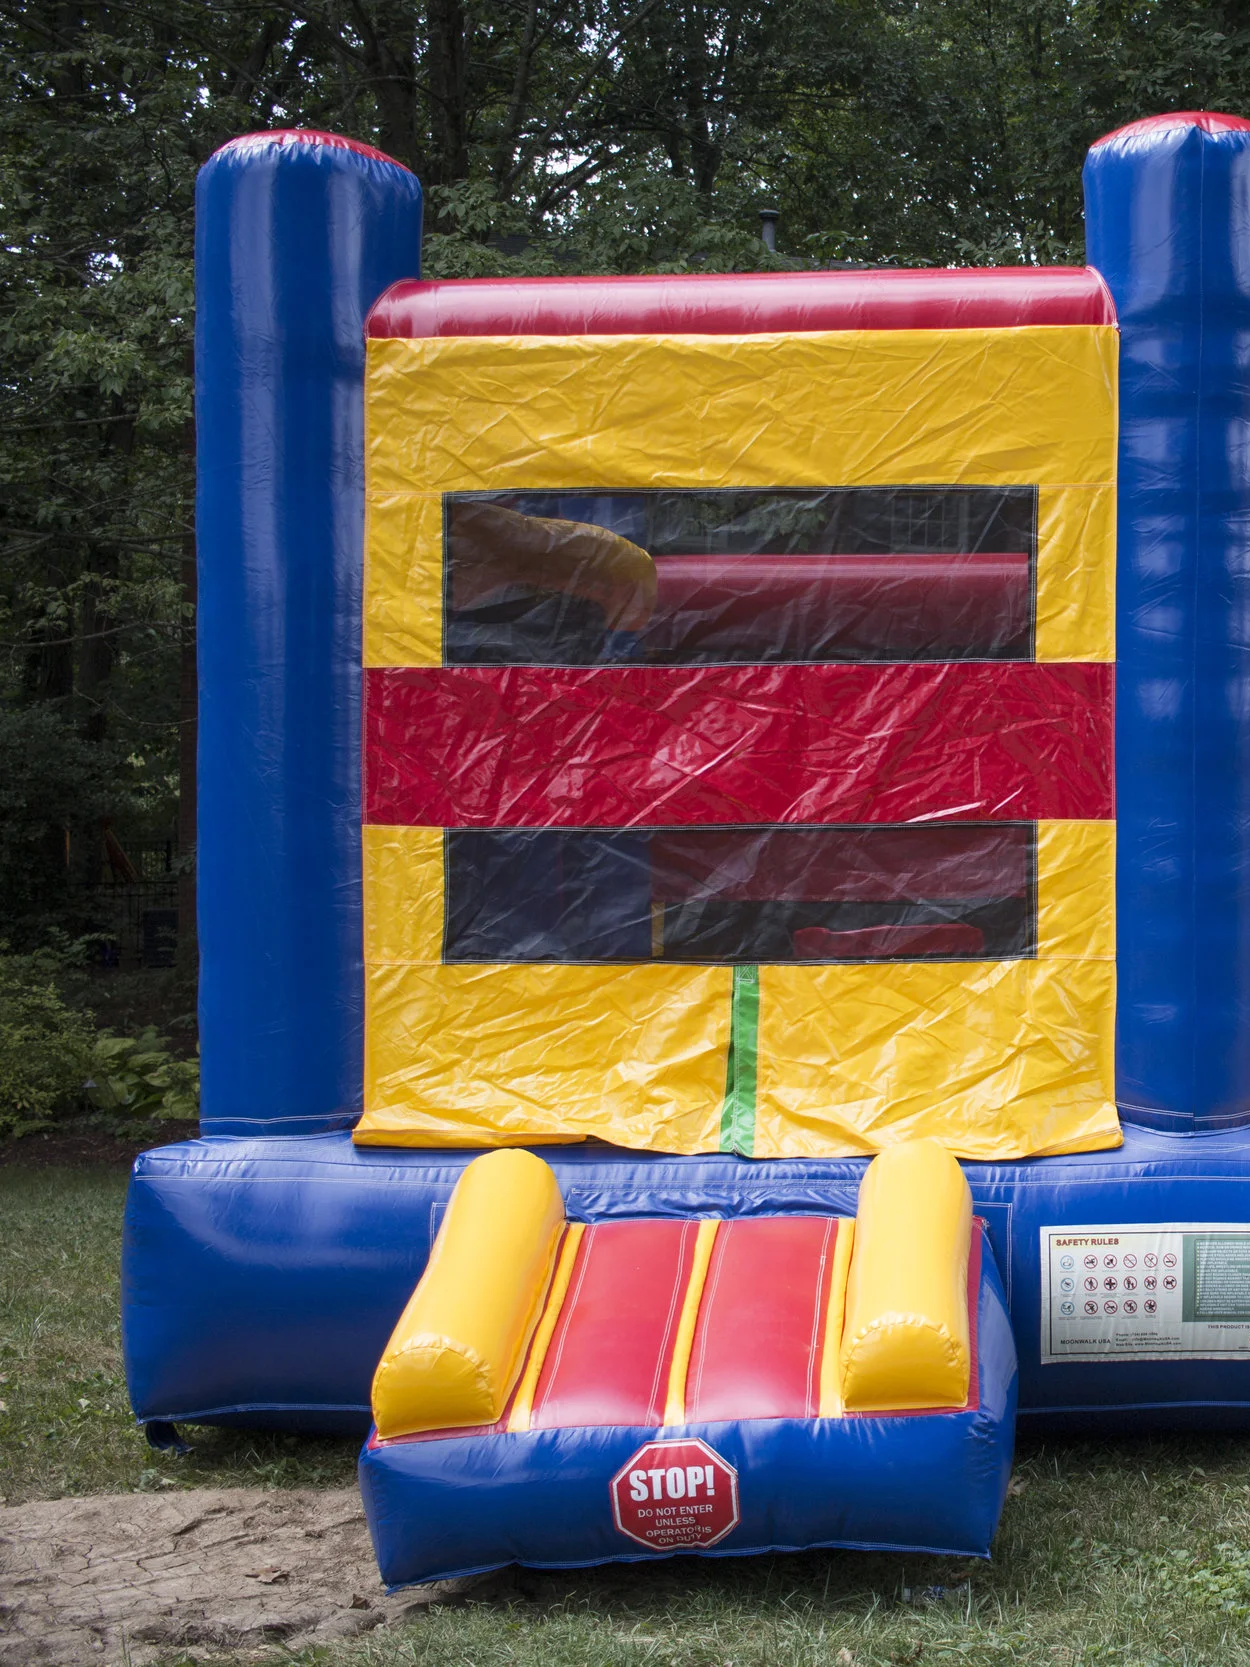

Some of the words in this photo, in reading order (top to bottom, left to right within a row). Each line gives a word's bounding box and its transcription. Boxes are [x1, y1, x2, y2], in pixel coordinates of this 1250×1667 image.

[629, 1465, 715, 1501] STOP!
[637, 1508, 653, 1518] DO
[656, 1507, 677, 1516] NOT
[680, 1504, 713, 1515] ENTER
[656, 1516, 695, 1527] UNLESS
[646, 1526, 701, 1537] OPERATOR
[658, 1536, 674, 1544] ON
[676, 1532, 702, 1542] DUTY
